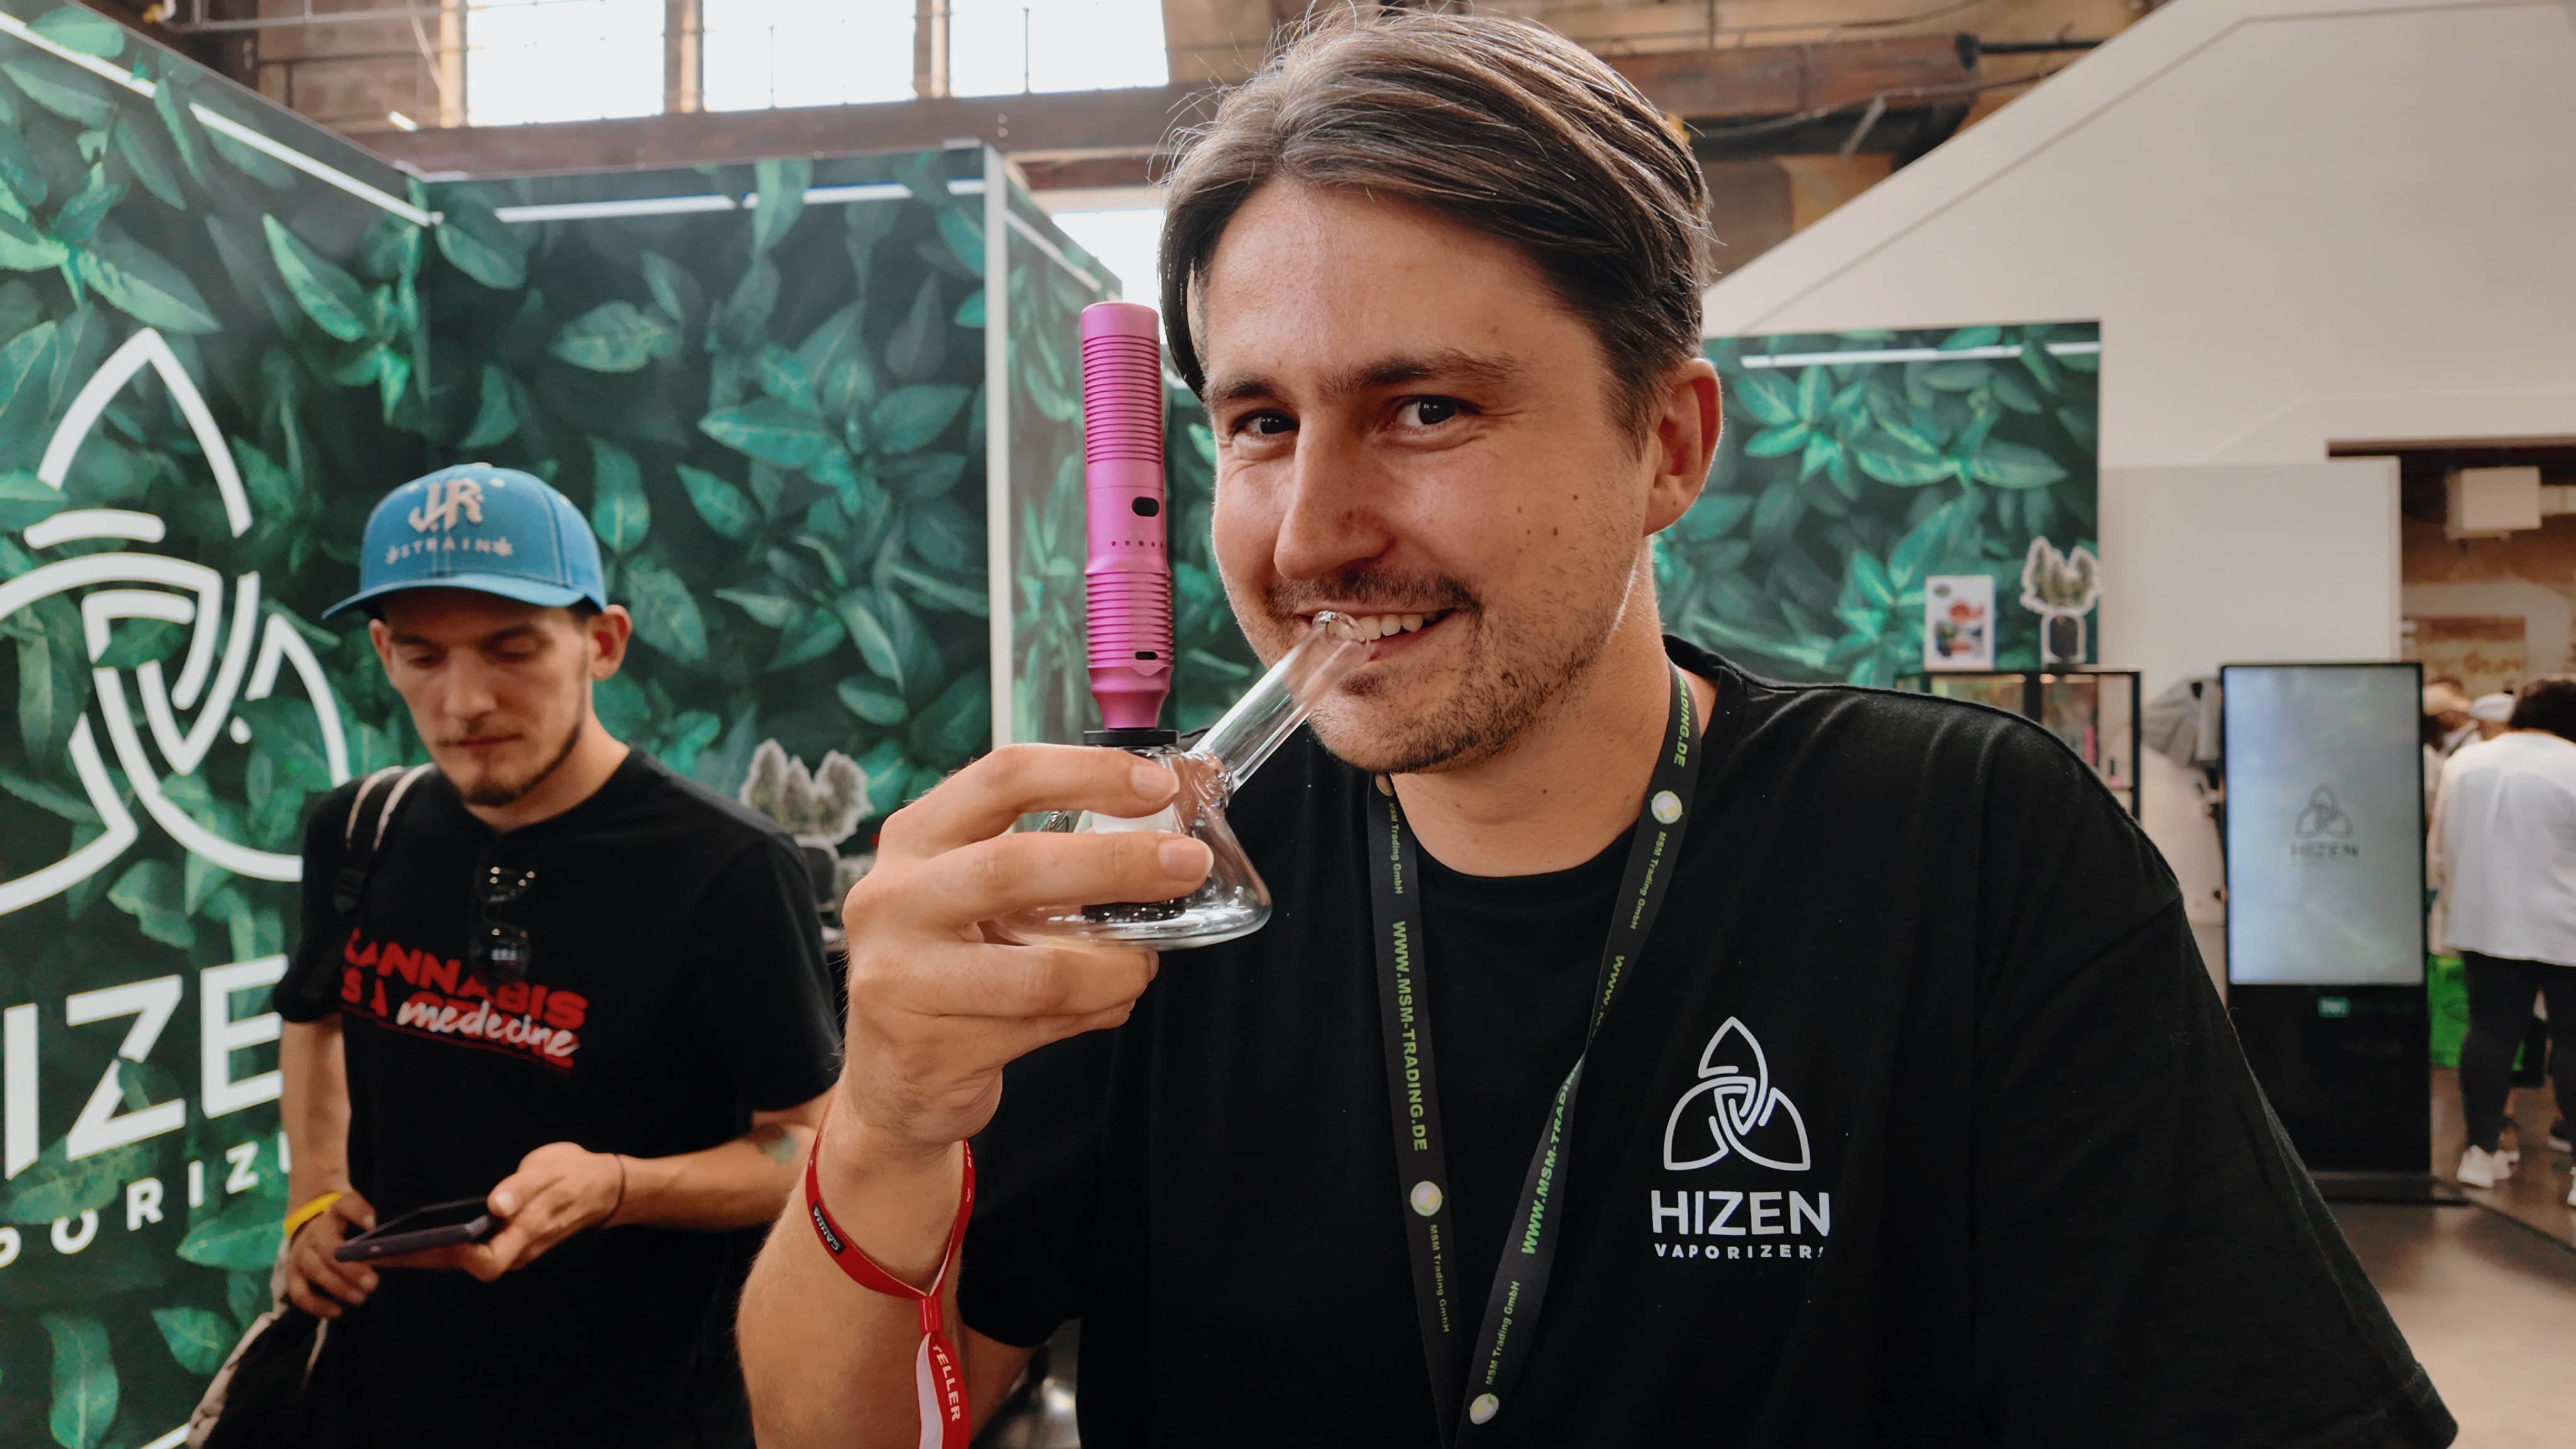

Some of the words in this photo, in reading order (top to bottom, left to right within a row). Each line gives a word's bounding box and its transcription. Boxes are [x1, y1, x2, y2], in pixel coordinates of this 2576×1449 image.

[1391, 824, 1401, 861] Trading
[1653, 831, 1667, 857] MSM
[1393, 863, 1403, 894] GmbH
[1640, 858, 1659, 896] Trading
[1630, 898, 1646, 930] GmbH
[1392, 921, 1428, 1151] WWW.MSM-TRADING.DE
[813, 1206, 841, 1250] CANNA
[1651, 1190, 1831, 1237] HIZEN
[1430, 1224, 1440, 1251] MSM
[1433, 1253, 1444, 1296] Trading
[1439, 1299, 1450, 1332] GmbH
[1485, 1360, 1499, 1385] MSM
[1492, 1317, 1513, 1357] Trading
[1504, 1280, 1520, 1314] GmbH
